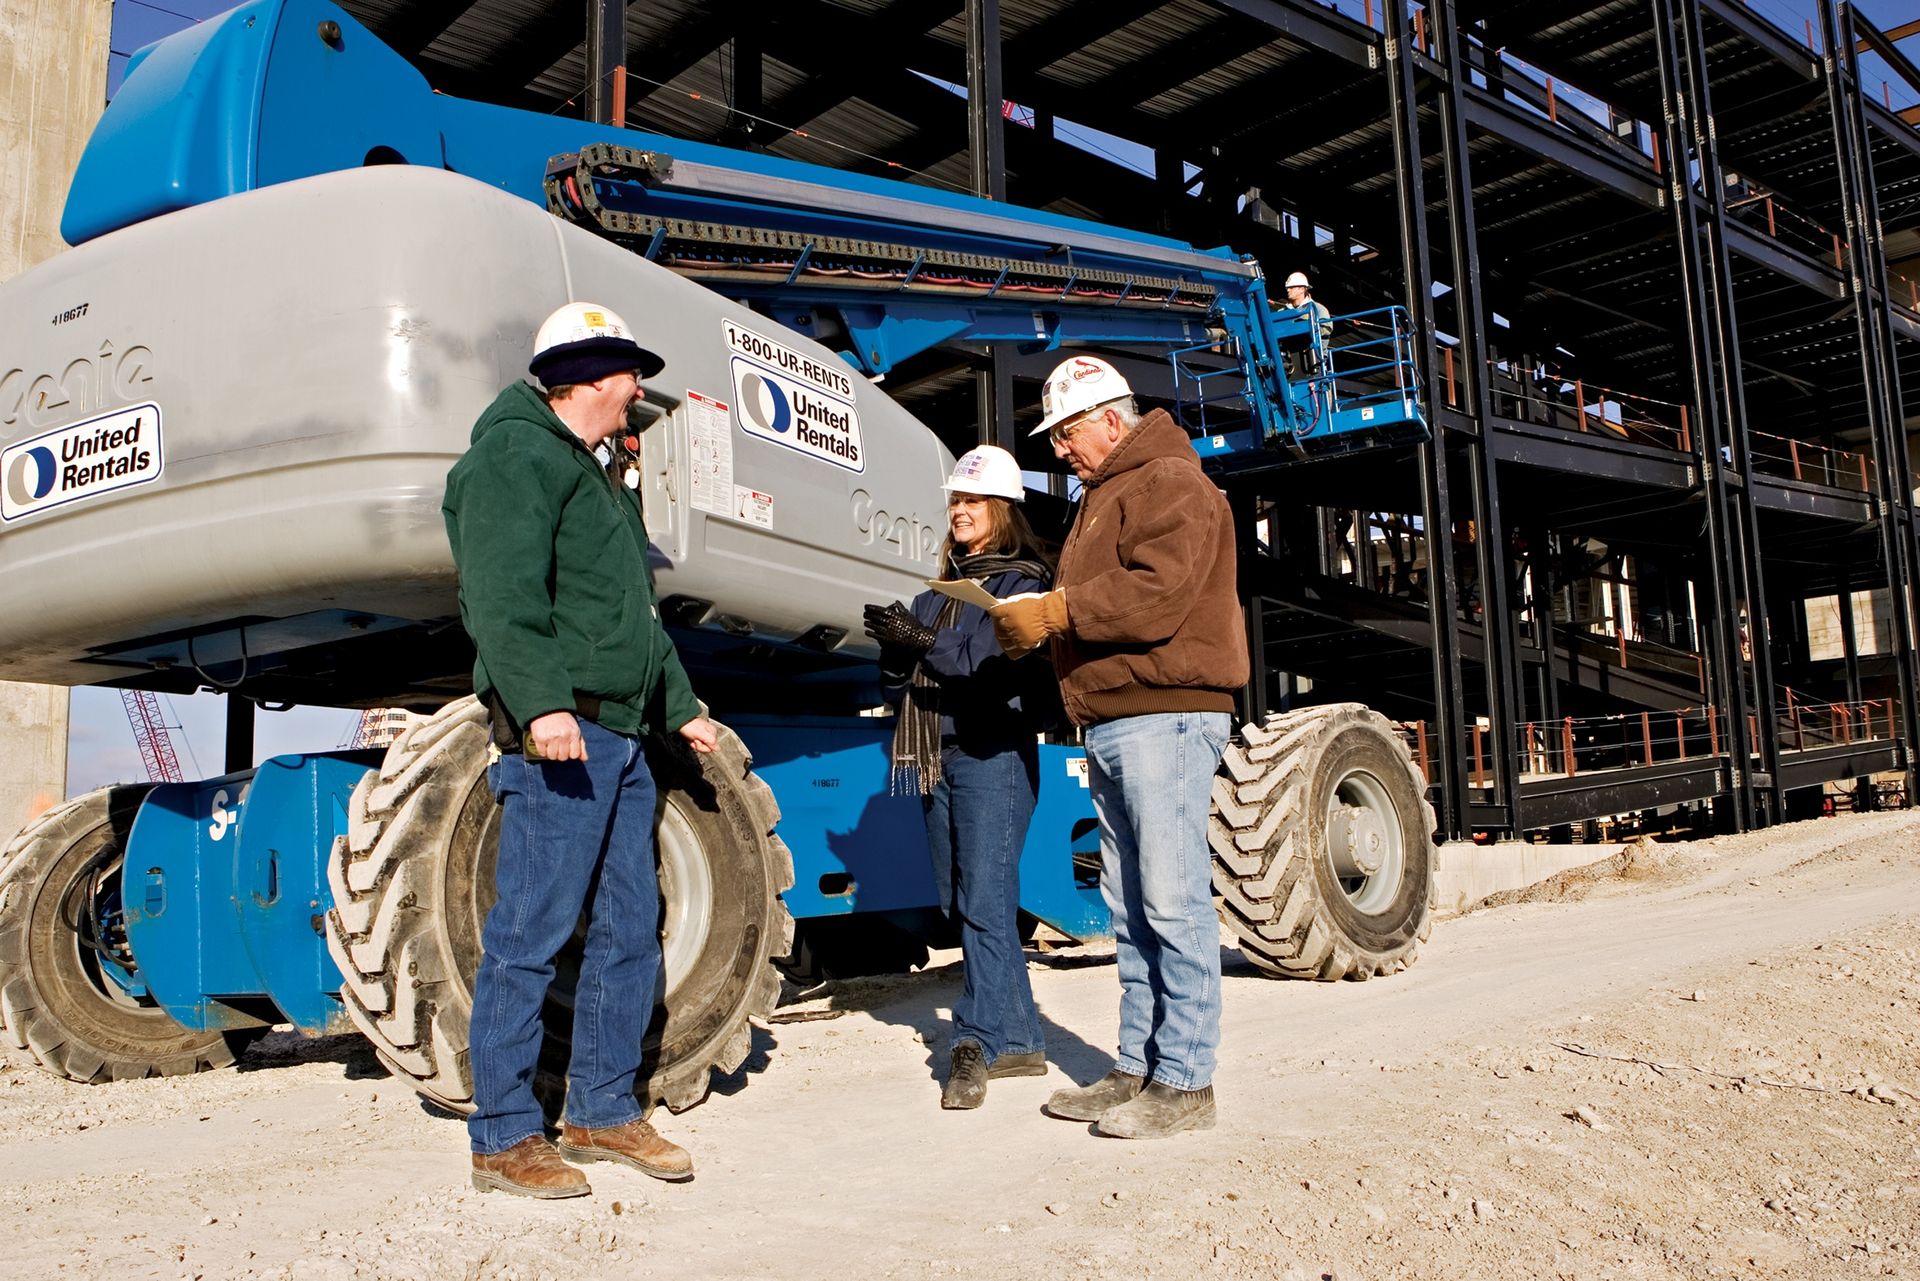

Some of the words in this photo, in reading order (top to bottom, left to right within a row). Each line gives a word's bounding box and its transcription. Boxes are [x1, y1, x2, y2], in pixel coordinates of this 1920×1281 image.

[52, 302, 89, 326] 418677
[728, 327, 851, 395] 1-800-UR-RENTS
[793, 391, 849, 434] United
[61, 417, 142, 463] United
[796, 418, 858, 461] Rentals
[61, 447, 151, 492] Rentals
[850, 488, 940, 568] Genie
[811, 778, 840, 788] 418677
